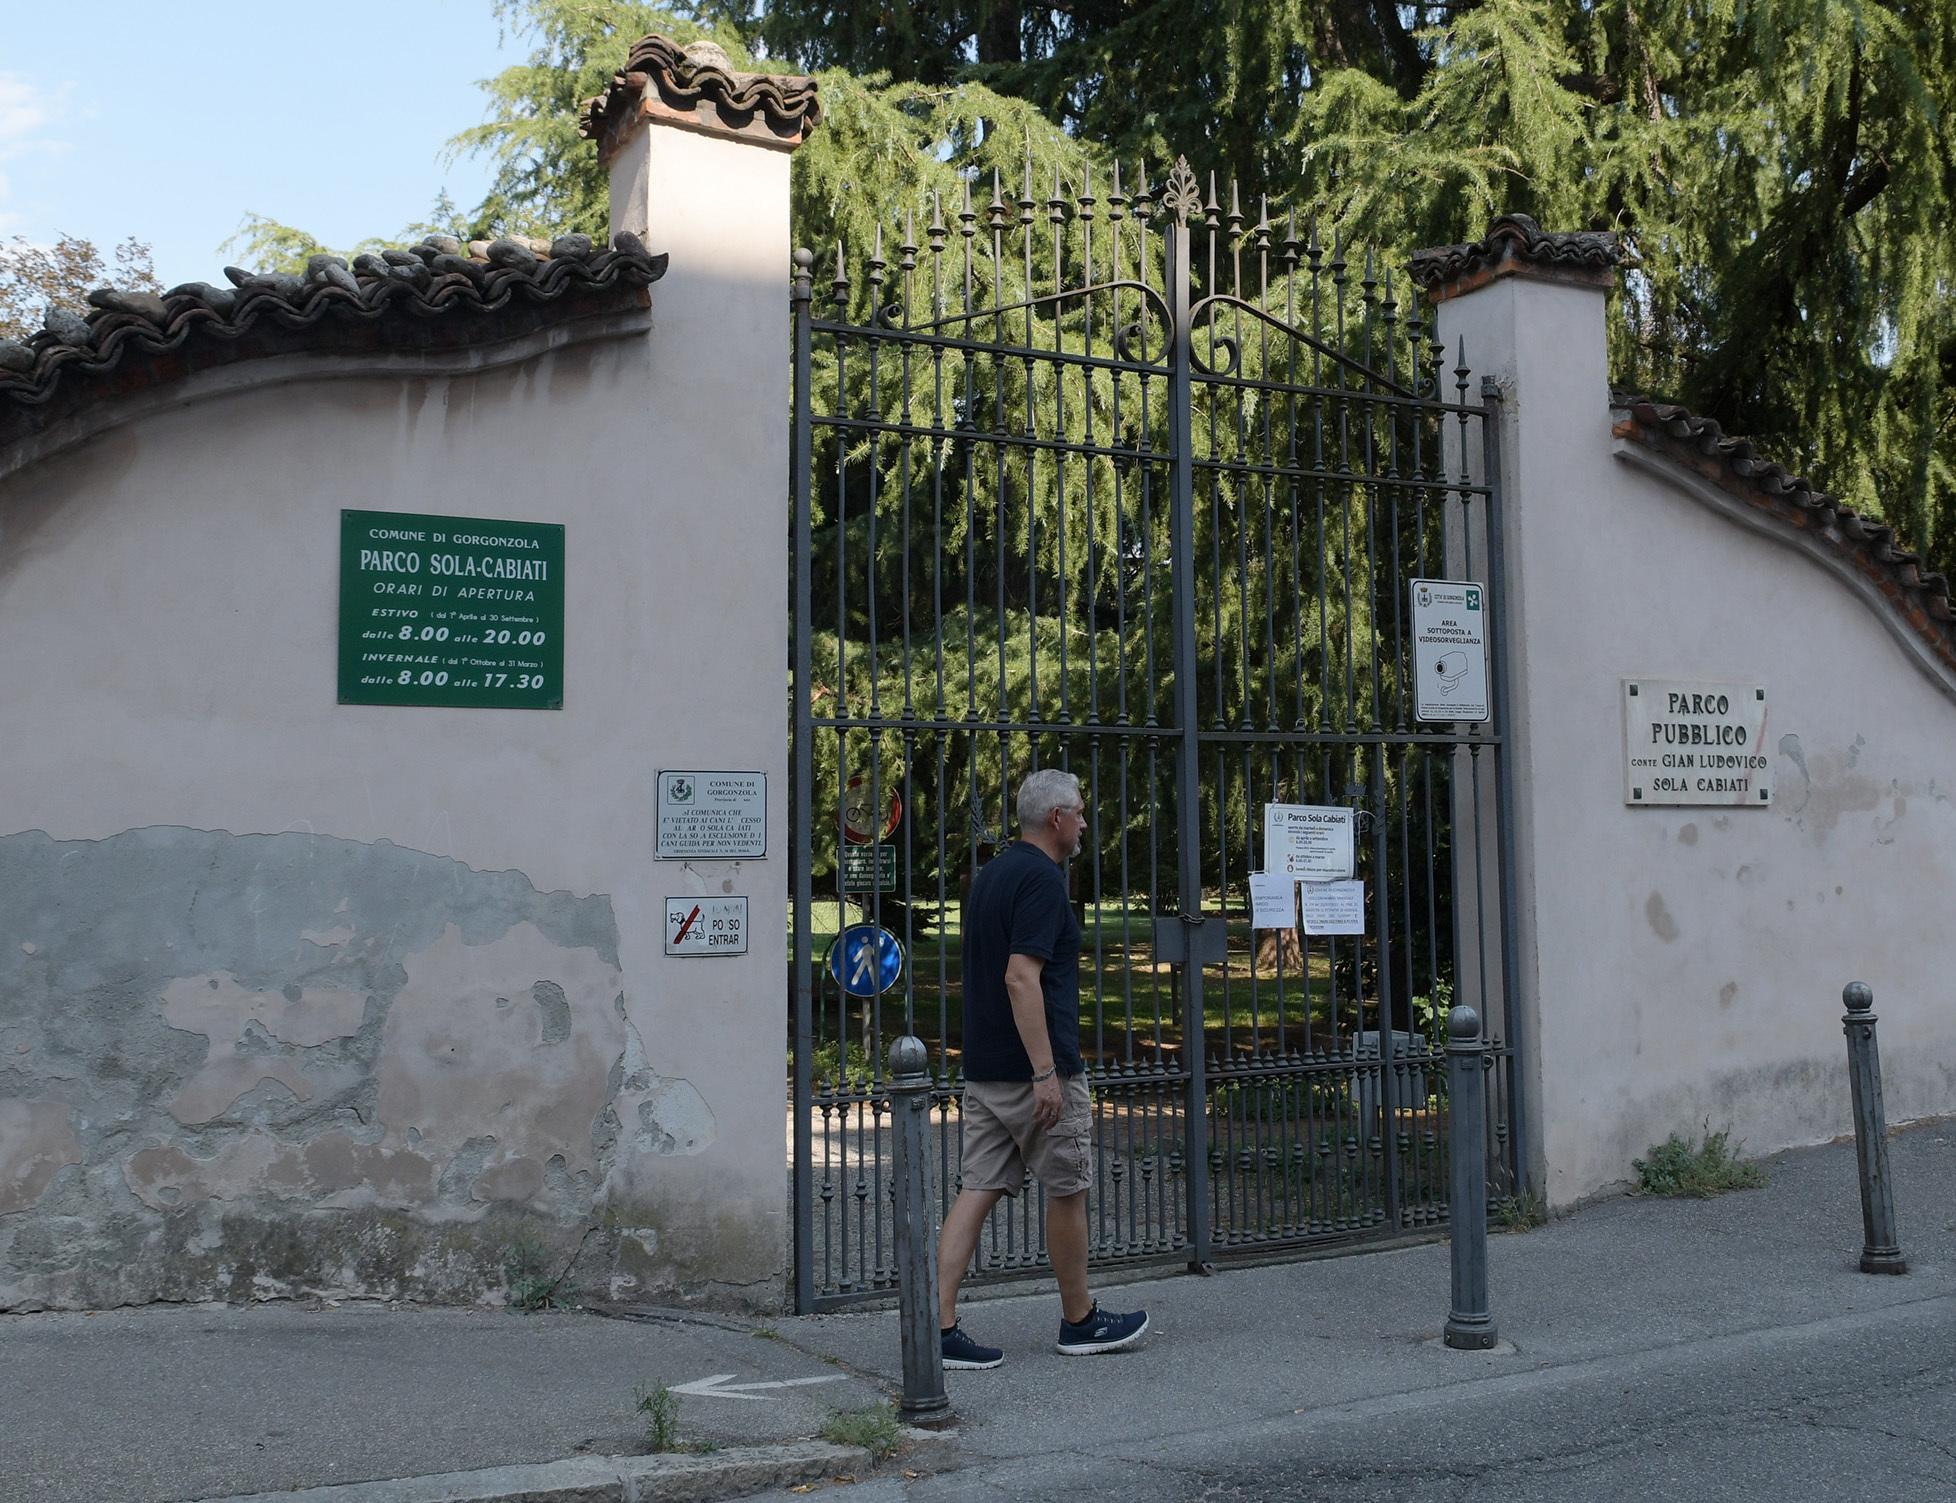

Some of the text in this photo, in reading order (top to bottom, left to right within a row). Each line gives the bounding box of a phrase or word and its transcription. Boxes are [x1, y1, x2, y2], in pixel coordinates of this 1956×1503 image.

[369, 528, 540, 549] COMUNE DI GORGONZOLA
[360, 549, 548, 581] PARCO SOLA-CABIATI
[373, 582, 536, 602] ORARI DI APERTURA
[371, 608, 419, 618] ESTIVO
[459, 613, 478, 621] Aprile
[362, 625, 546, 646] dalle 8.00 alle 20.00
[1427, 627, 1465, 636] SOTTOPOSTA
[1419, 636, 1480, 645] VIDEOSORVEGLIANZA
[362, 654, 439, 664] INVERNALE
[471, 659, 497, 667] Ottobre
[361, 670, 545, 689] dalle 8.00 alle 17.30
[1668, 693, 1729, 715] PARCO
[1651, 723, 1747, 746] PUBBLICO
[1631, 754, 1767, 770] CONTE GIAN LUDOVICO
[1653, 778, 1749, 792] SOLA CABIATI
[1288, 813, 1346, 825] Parco Sola Cabiati
[713, 919, 741, 931] POSO
